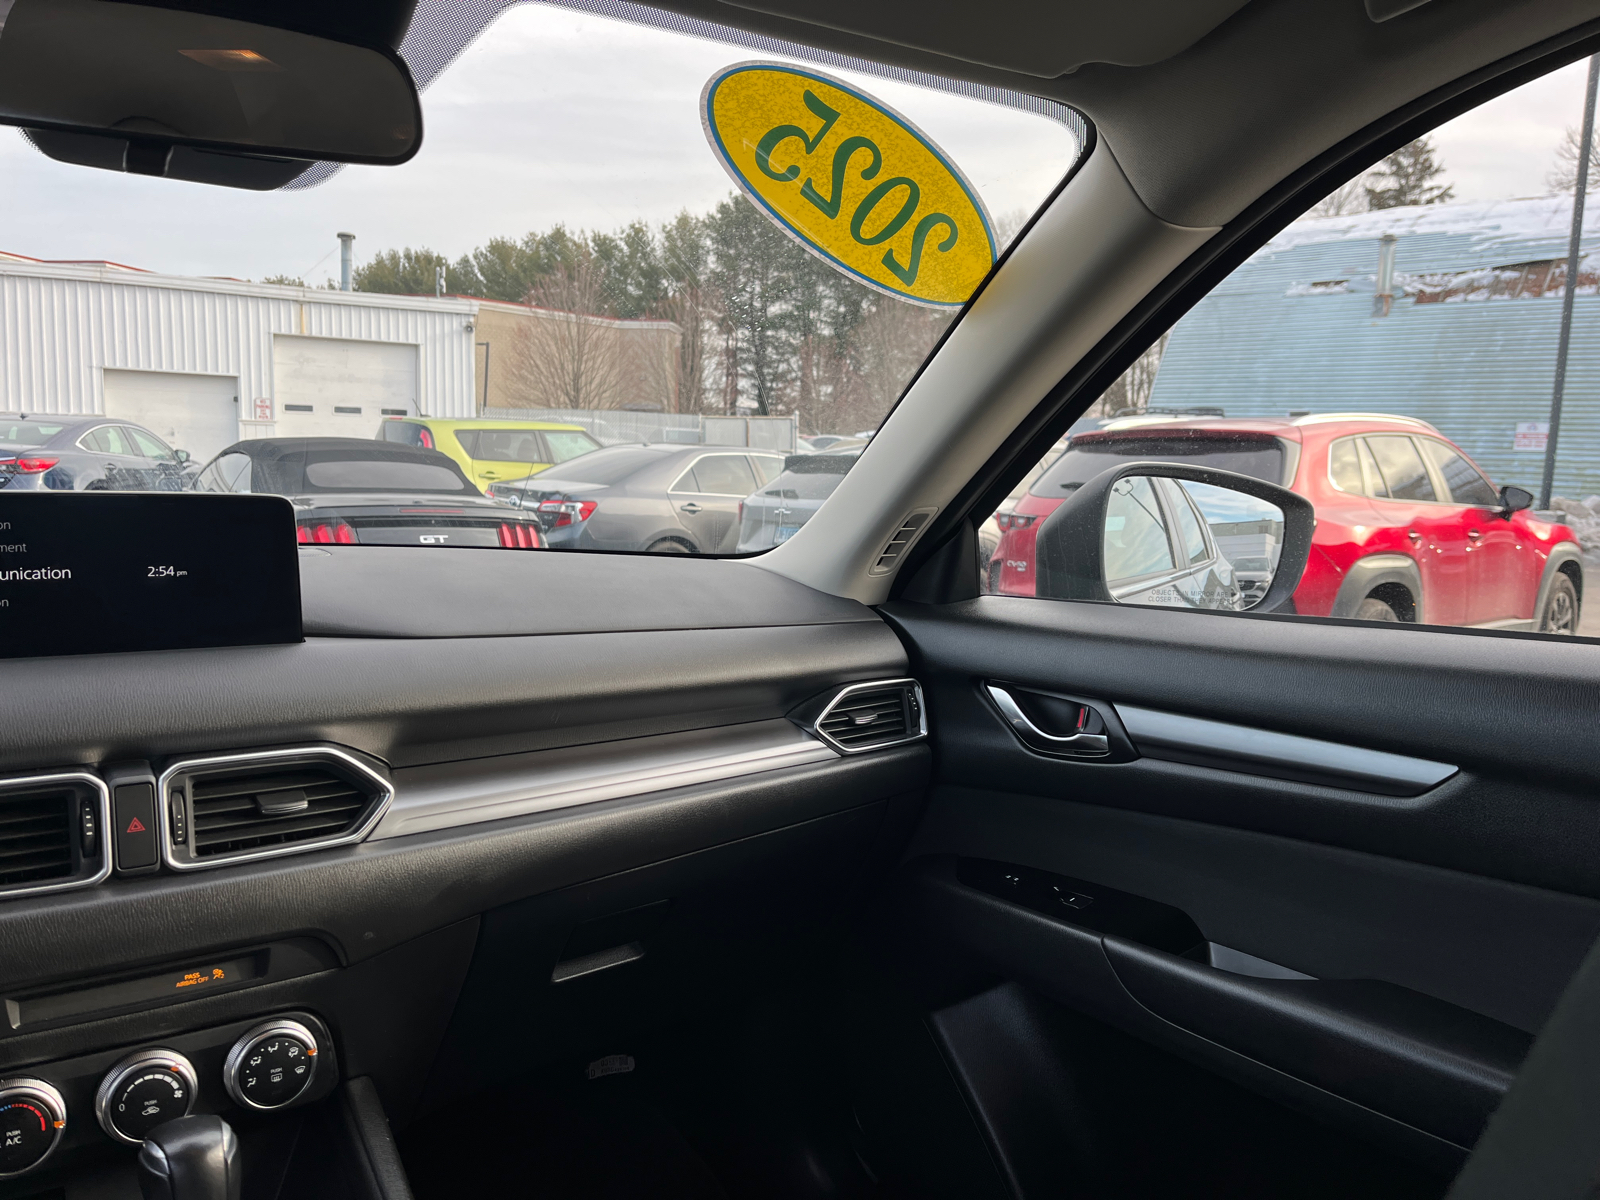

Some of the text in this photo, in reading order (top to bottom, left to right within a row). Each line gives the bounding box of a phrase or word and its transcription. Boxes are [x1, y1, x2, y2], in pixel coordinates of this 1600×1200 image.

[419, 534, 449, 544] GT
[147, 565, 175, 577] 2:54
[184, 972, 200, 980] PASS
[176, 976, 209, 988] AIRBAG OFF
[5, 1136, 22, 1146] A/C
